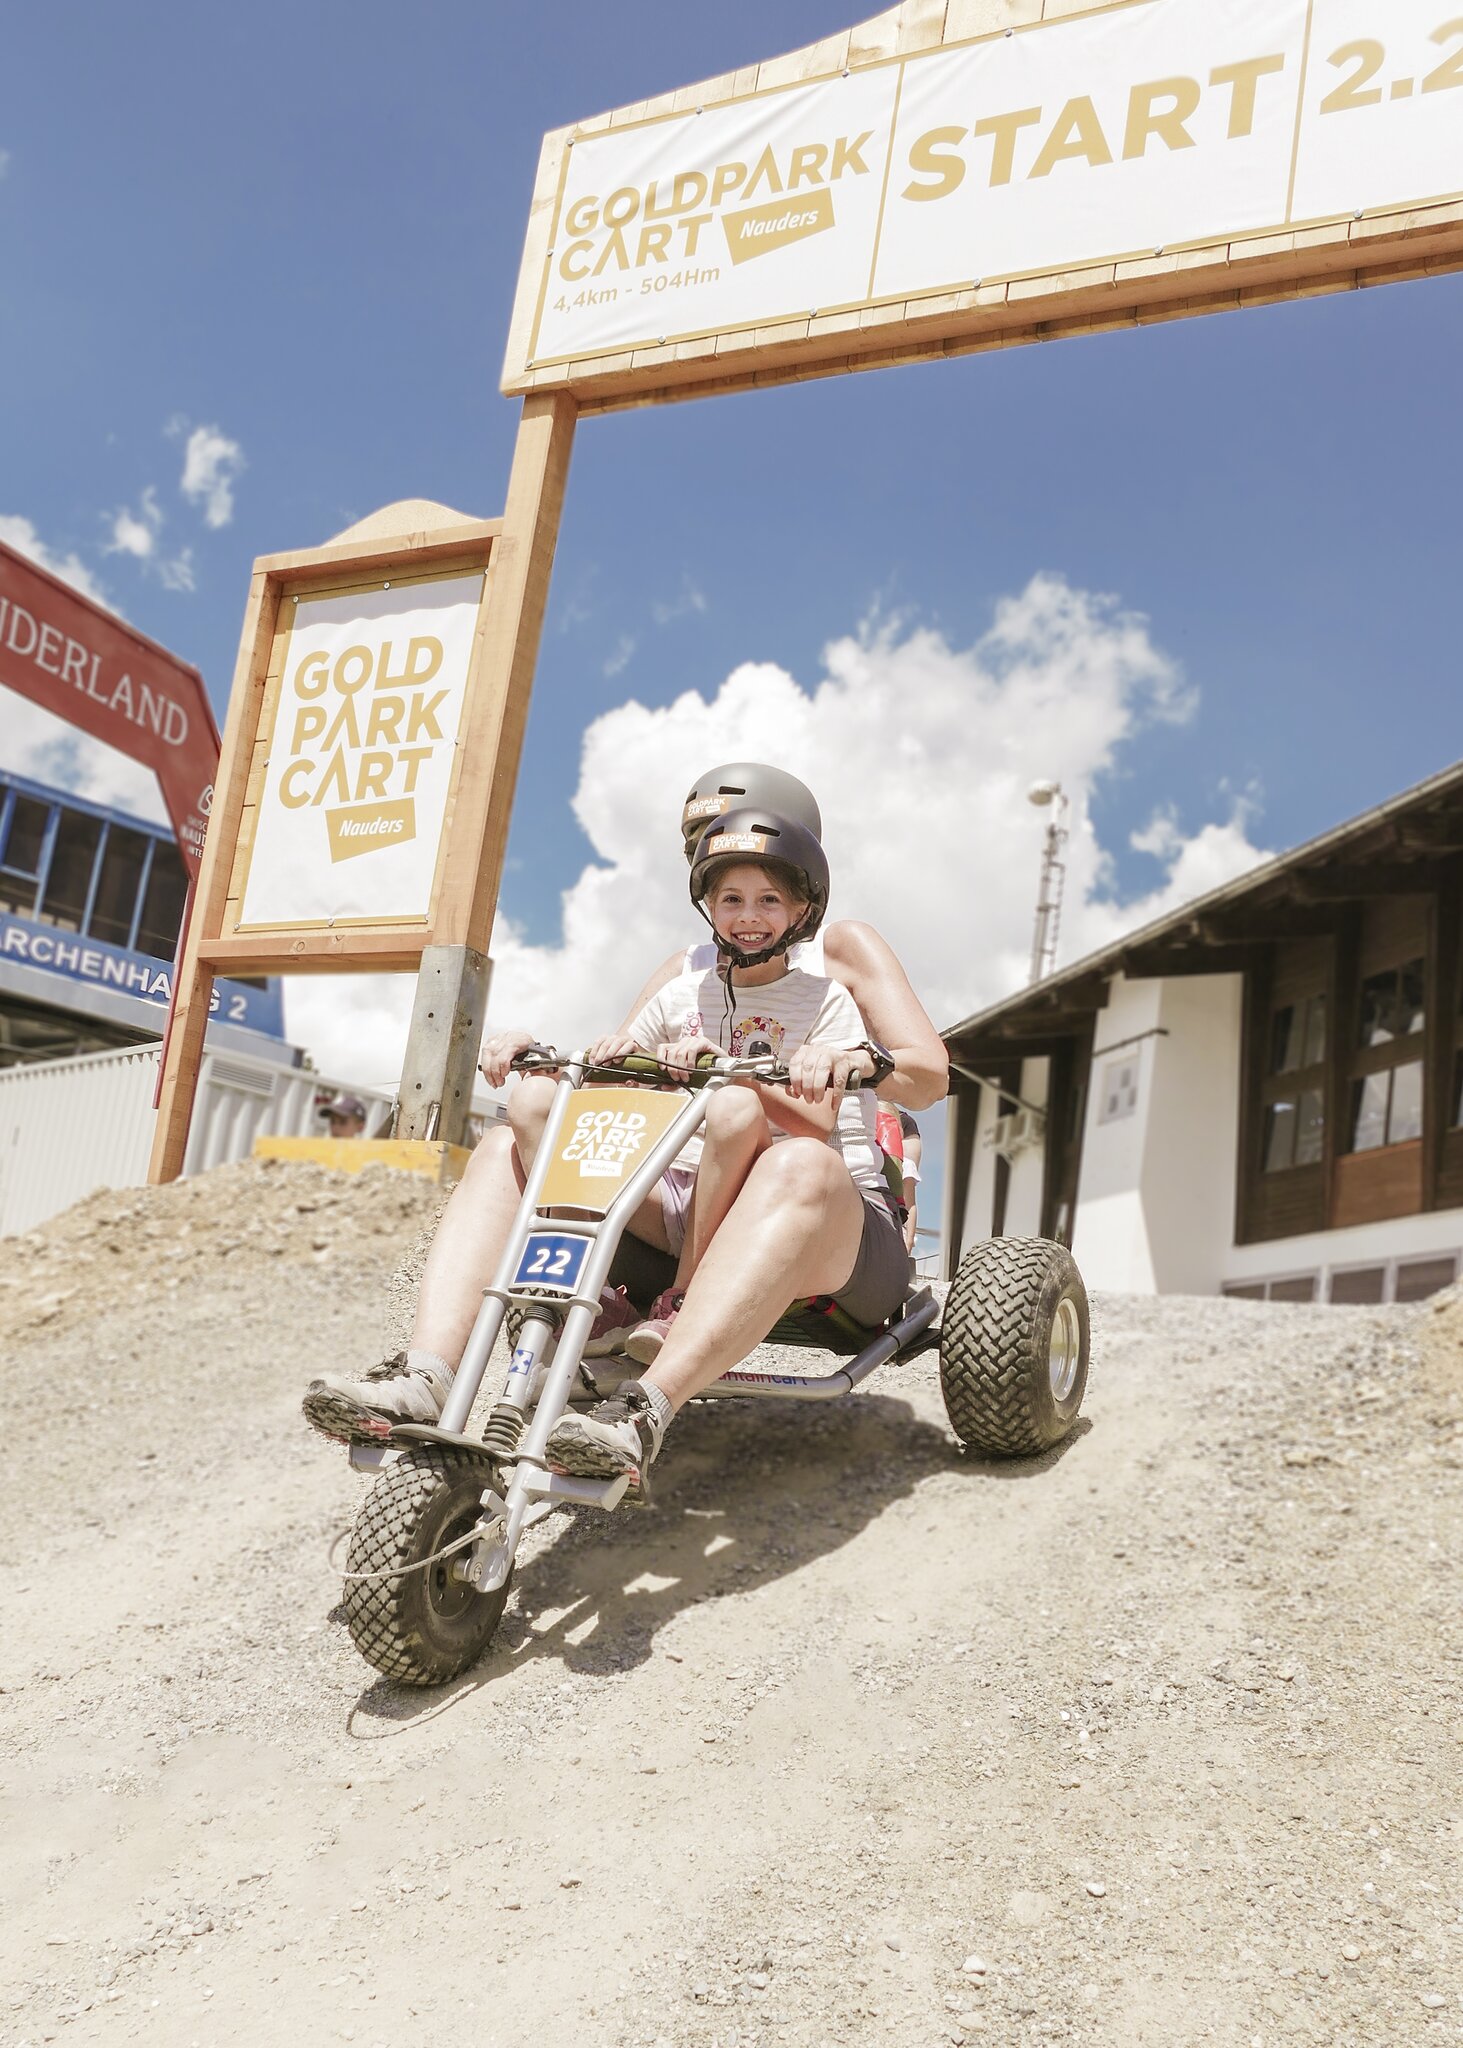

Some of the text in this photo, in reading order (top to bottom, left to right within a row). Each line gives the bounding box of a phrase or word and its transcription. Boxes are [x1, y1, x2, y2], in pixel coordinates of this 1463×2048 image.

[900, 53, 1285, 202] START
[565, 130, 875, 237] GOLDPARK
[559, 208, 819, 281] CART Nauders
[553, 288, 617, 312] 4,4km
[640, 267, 720, 295] 504Hm
[294, 636, 443, 700] GOLD
[290, 689, 451, 755] PARK
[279, 742, 433, 809] CART
[339, 817, 404, 837] Nauders
[713, 834, 761, 844] GOLDPARK
[713, 841, 736, 850] CART
[0, 926, 248, 1021] RCHENHAG 2
[570, 1126, 647, 1149] PARK
[576, 1111, 647, 1130] GOLD
[562, 1139, 635, 1163] CART
[526, 1248, 572, 1275] 22
